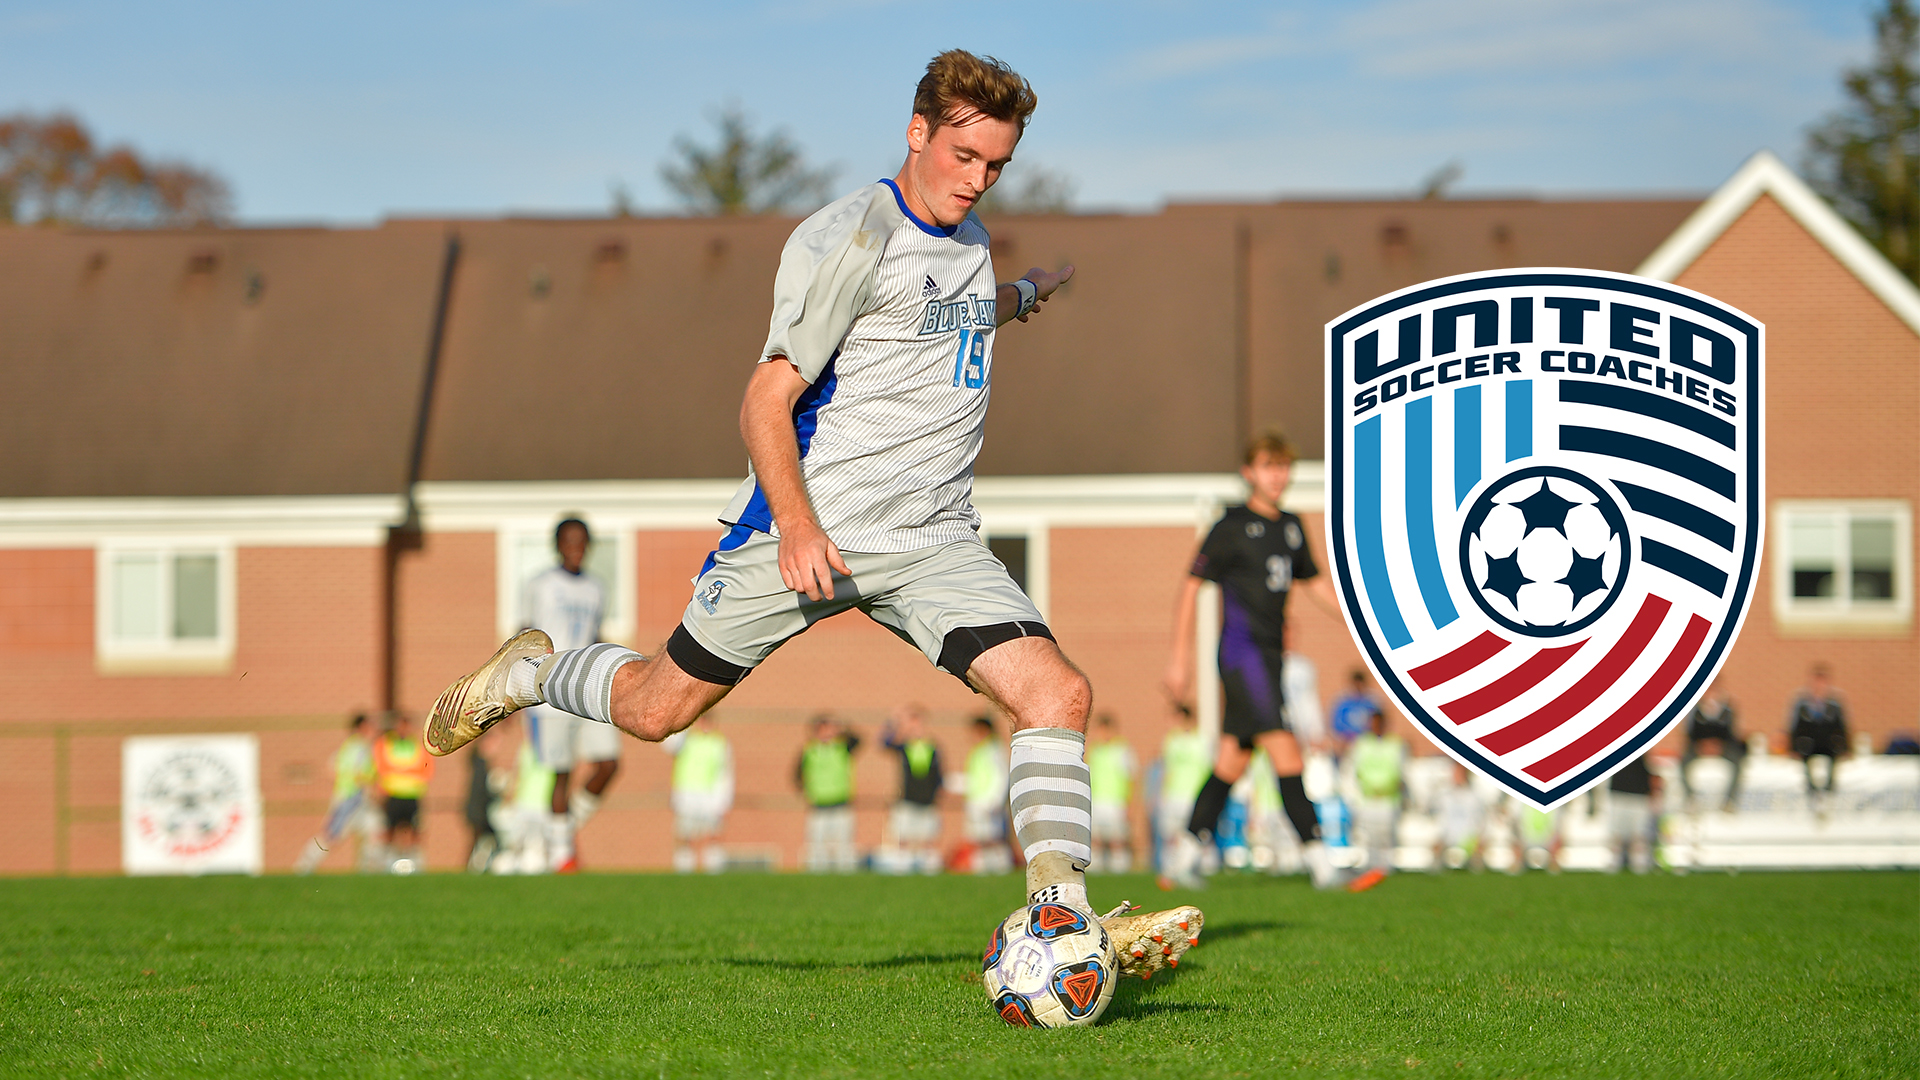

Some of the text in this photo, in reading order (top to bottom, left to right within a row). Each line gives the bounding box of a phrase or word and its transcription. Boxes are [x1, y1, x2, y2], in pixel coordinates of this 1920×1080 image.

[917, 300, 972, 336] BLUE
[967, 293, 997, 328] JAY
[952, 328, 985, 390] 19
